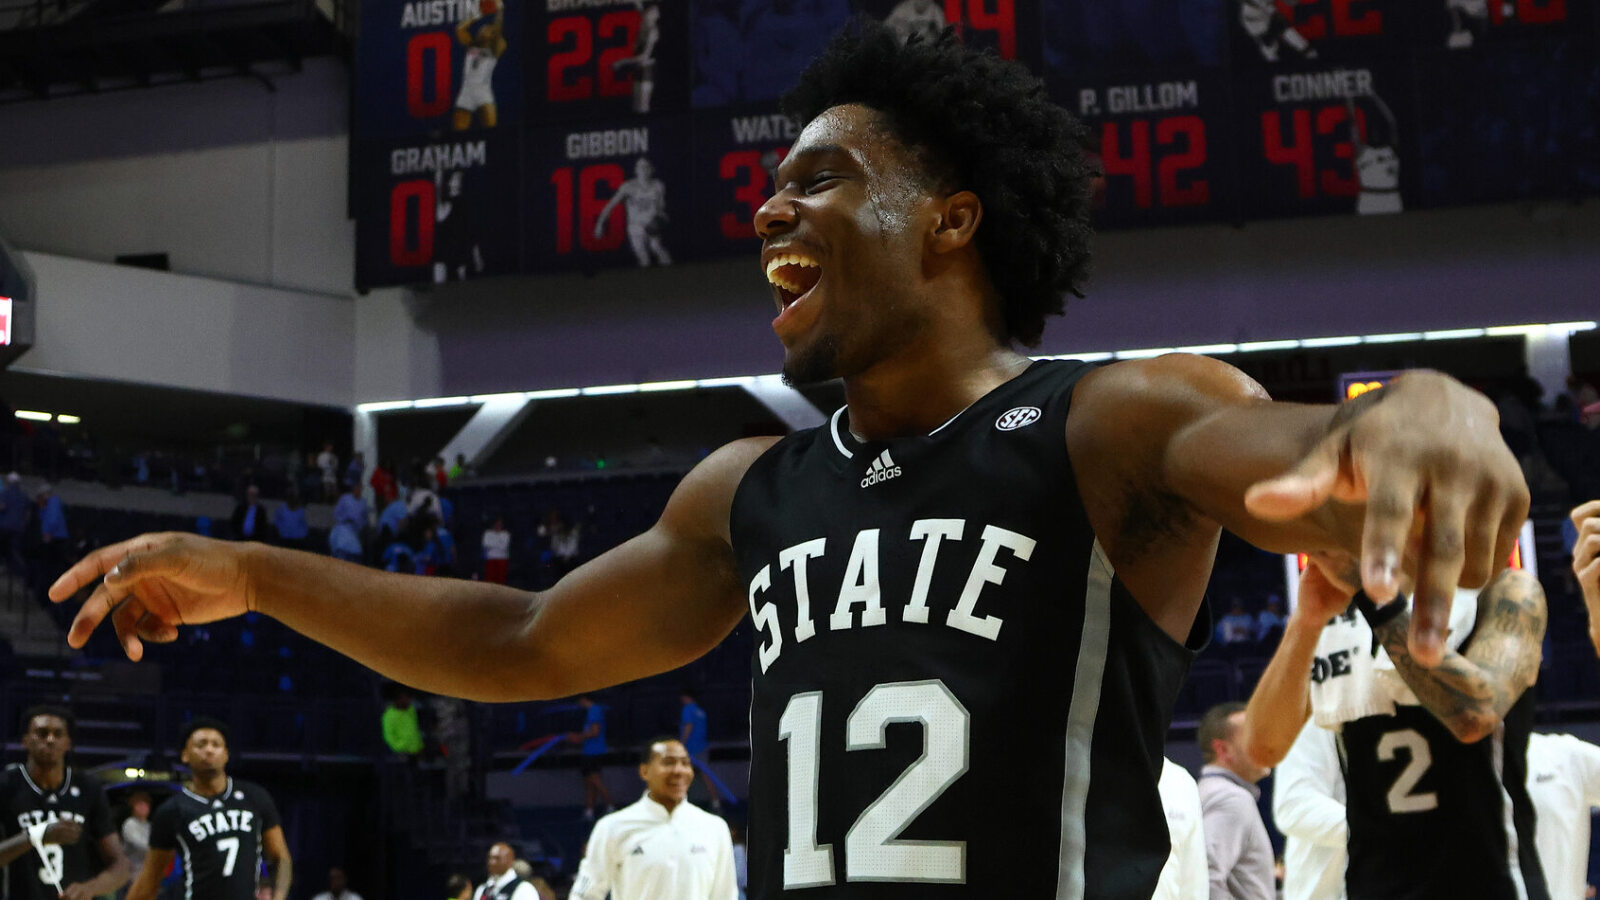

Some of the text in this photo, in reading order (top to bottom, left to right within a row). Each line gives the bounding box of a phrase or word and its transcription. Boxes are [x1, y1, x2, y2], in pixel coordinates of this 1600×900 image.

[400, 0, 481, 29] AUSTIN
[406, 31, 452, 119] 0
[546, 10, 642, 101] 22
[1273, 68, 1372, 102] CONNER
[1079, 80, 1199, 117] P. GILLOM
[391, 140, 487, 175] GRAHAM
[565, 127, 649, 159] GIBBON
[1101, 115, 1210, 209] 42
[1261, 105, 1367, 198] 43
[390, 179, 436, 268] 0
[550, 163, 627, 256] 16
[998, 407, 1040, 430] SEC
[860, 466, 902, 489] adidas
[749, 518, 1037, 675] STATE
[778, 678, 970, 891] 12
[1376, 727, 1439, 815] 2
[188, 809, 254, 842] STATE
[216, 836, 240, 876] 7
